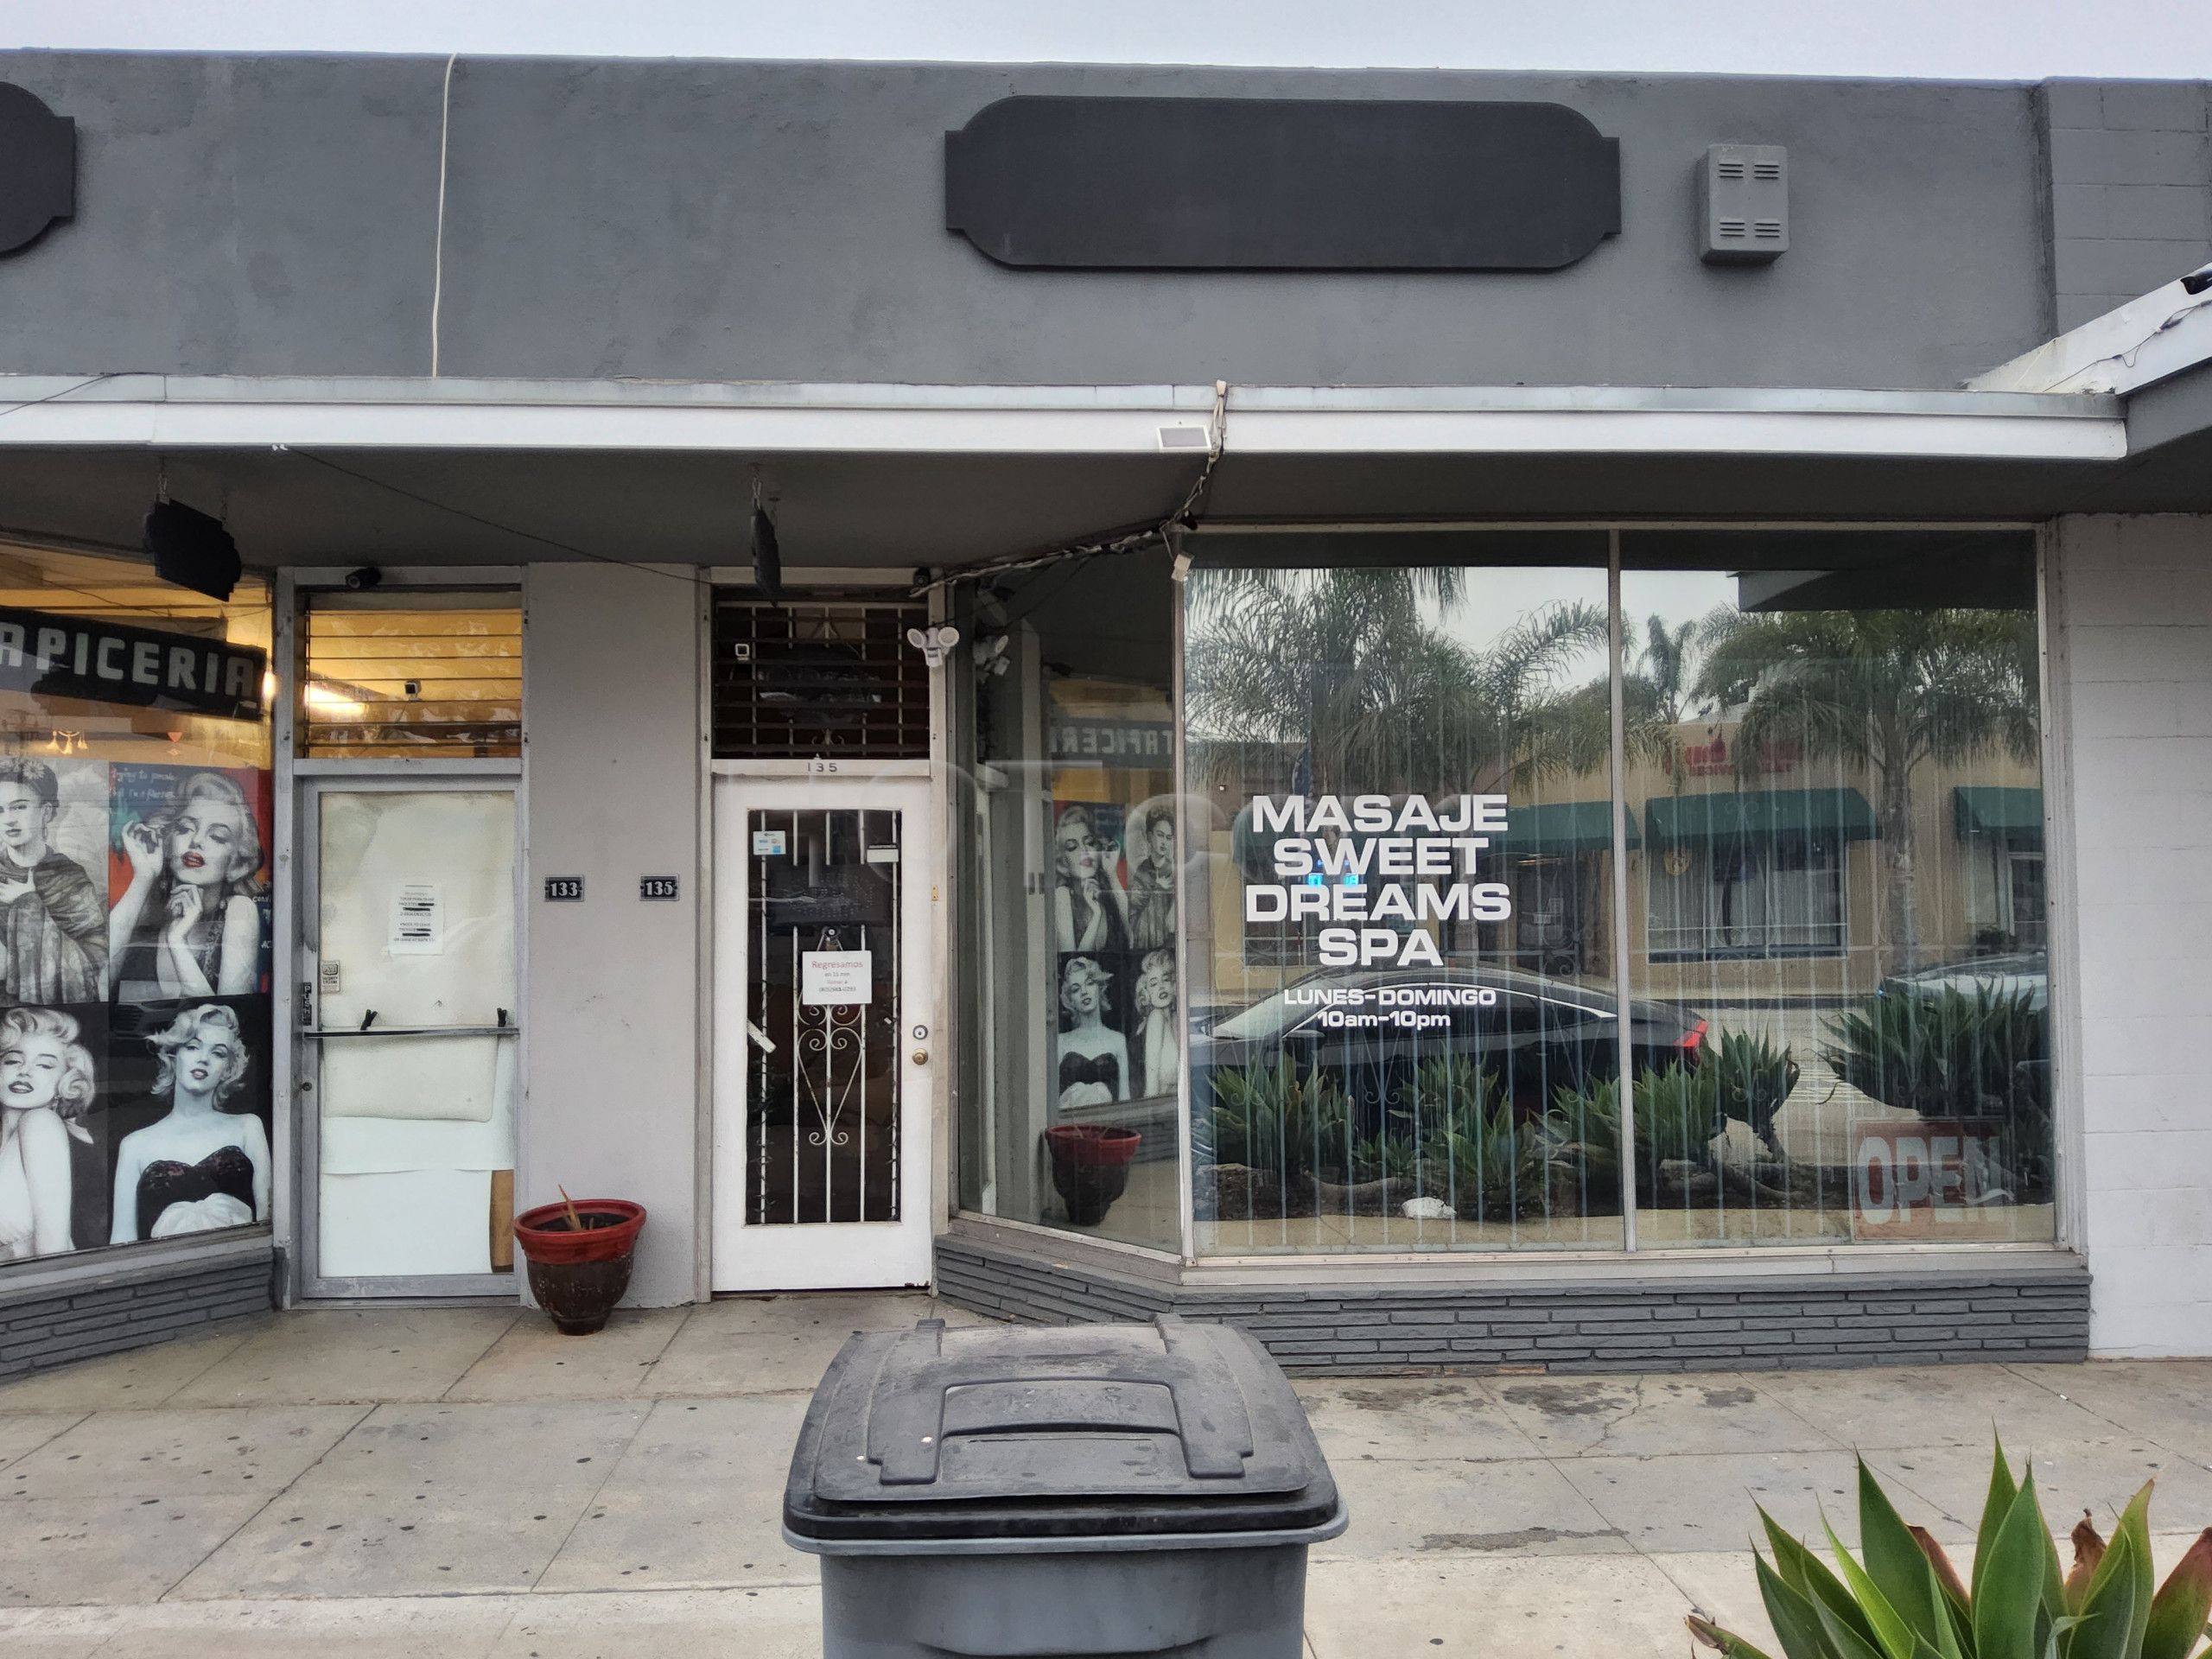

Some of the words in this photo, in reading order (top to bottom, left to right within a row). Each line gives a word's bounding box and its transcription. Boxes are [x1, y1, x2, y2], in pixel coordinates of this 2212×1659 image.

[807, 762, 837, 772] 135
[1252, 794, 1509, 832] MASAJE
[1273, 837, 1490, 876] SWEET
[550, 881, 578, 897] 133
[645, 880, 674, 896] 135
[1245, 882, 1512, 922] DREAMS
[1318, 928, 1445, 967] SPA
[811, 960, 864, 969] Regresamos
[1317, 1010, 1452, 1031] 10am-10pm
[1858, 1135, 2005, 1225] OPEN
